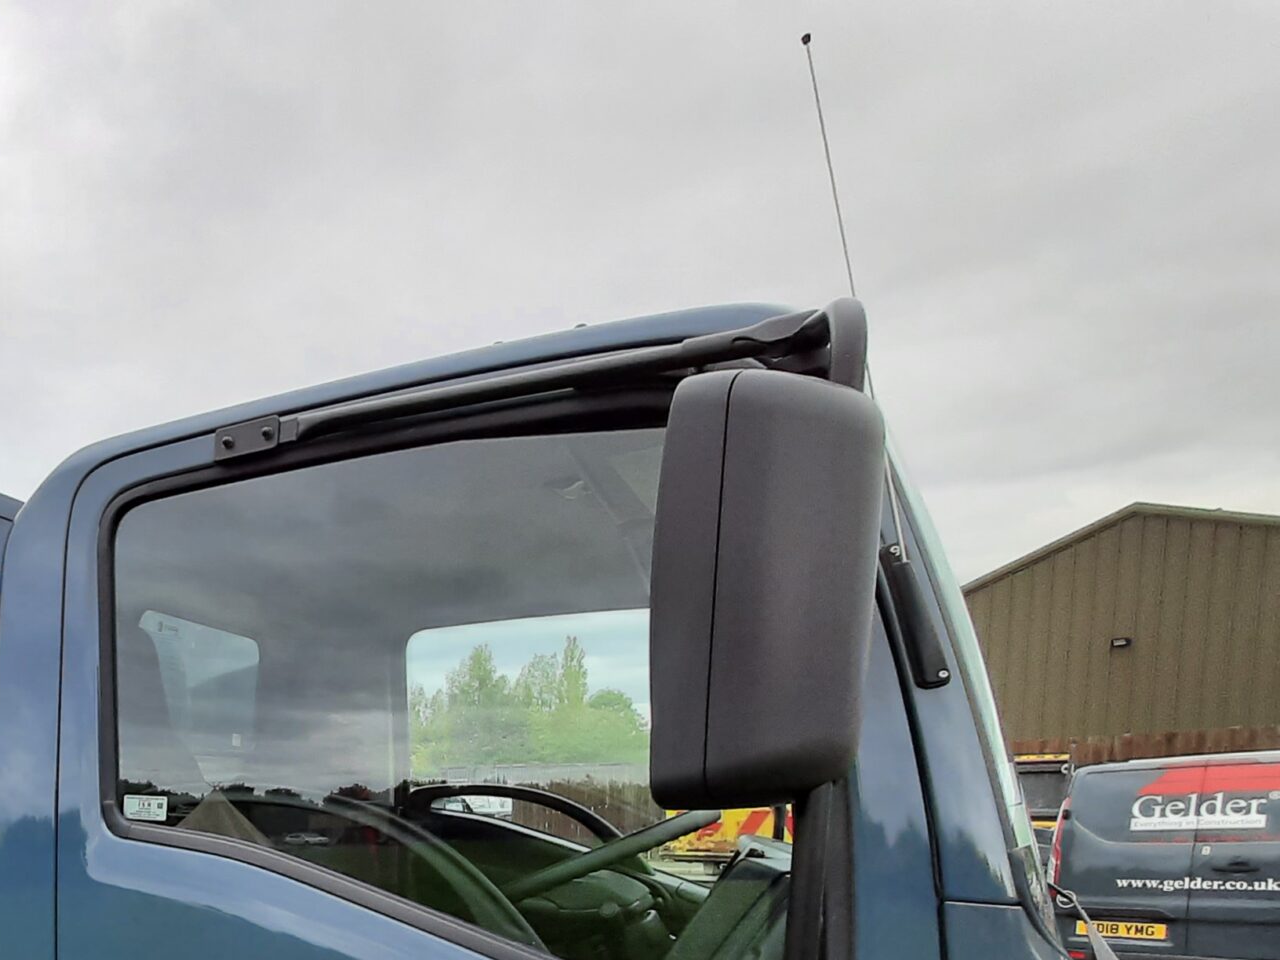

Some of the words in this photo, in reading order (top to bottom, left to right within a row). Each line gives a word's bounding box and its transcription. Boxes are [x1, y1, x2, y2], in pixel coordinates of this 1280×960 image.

[1131, 792, 1268, 819] Gelder
[1116, 876, 1280, 892] www.gelder.co.uk
[1091, 922, 1119, 934] D18
[1125, 924, 1155, 937] YMG
